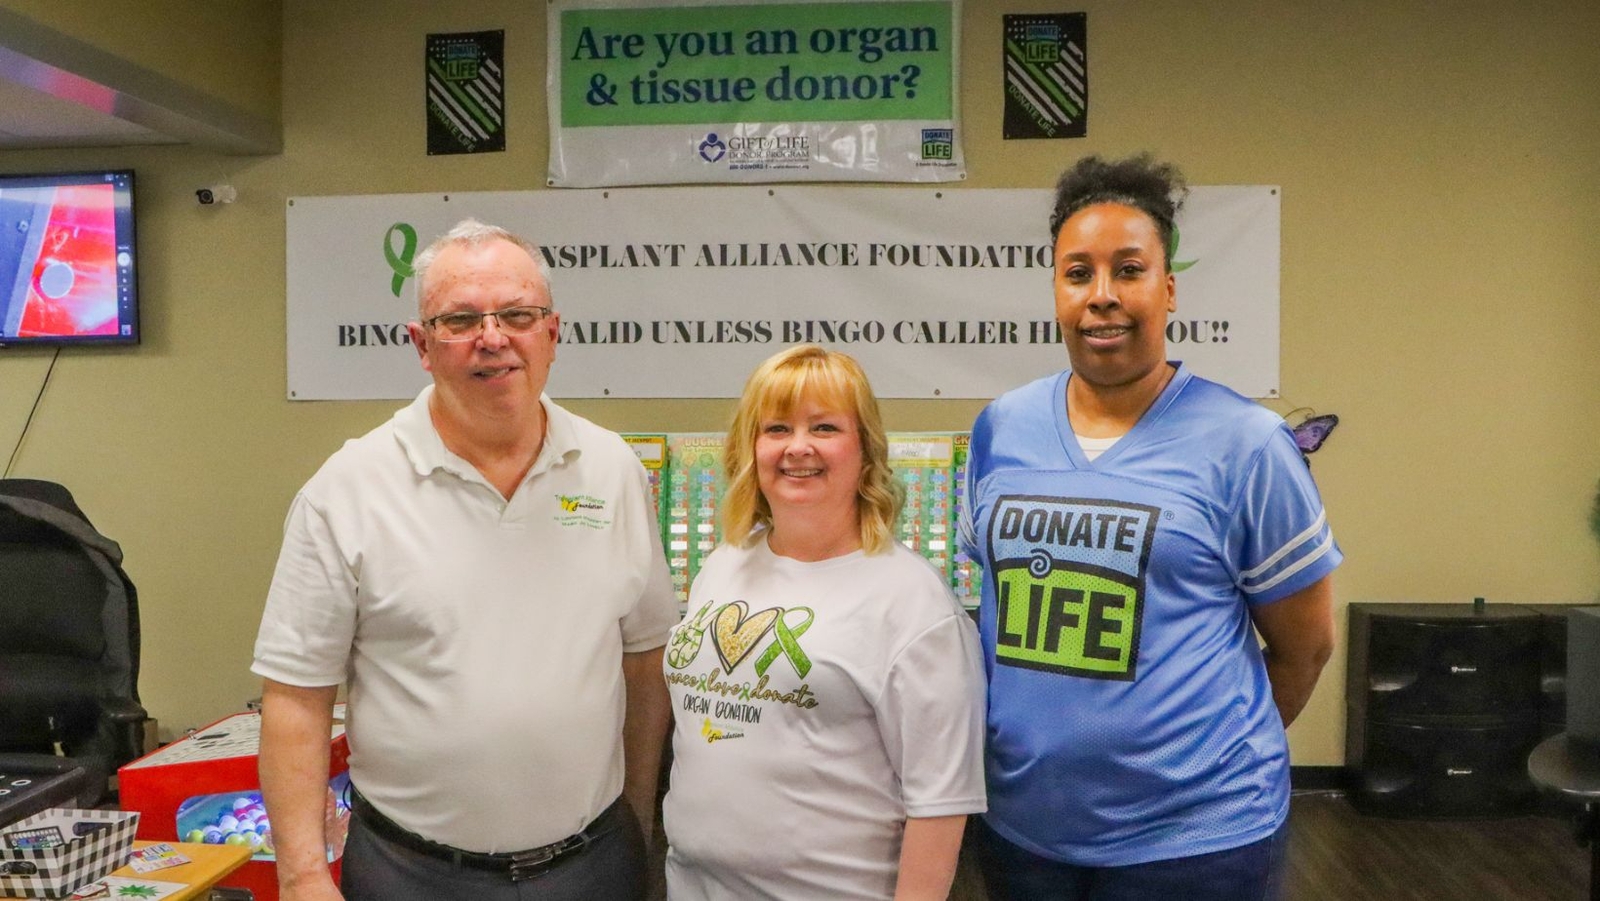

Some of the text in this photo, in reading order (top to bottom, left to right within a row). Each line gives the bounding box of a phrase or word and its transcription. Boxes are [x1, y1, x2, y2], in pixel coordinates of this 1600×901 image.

[571, 26, 939, 68] Are you an organ
[1028, 43, 1058, 59] LIFE
[449, 61, 476, 77] LIFE
[586, 65, 921, 106] & tissue donor?
[1008, 84, 1056, 138] DONATE LIFE
[430, 102, 477, 153] DONATE LIFE
[924, 131, 950, 139] DONATE
[728, 136, 810, 151] GIFT of LIFE
[729, 150, 810, 159] DONOR PROGRAM
[924, 144, 950, 156] LIFE
[539, 243, 1055, 268] NSPLANT ALLIANCE FOUNDATIO
[337, 322, 410, 346] BING
[651, 320, 773, 344] UNLESS
[782, 320, 886, 344] BINGO
[892, 320, 1018, 344] CALLER
[1165, 320, 1230, 344] OU!!
[998, 507, 1140, 553] DONATE
[997, 580, 1127, 661] LIFE
[707, 667, 743, 698] love
[750, 674, 819, 709] donate
[683, 693, 762, 723] ORGAN DONATION
